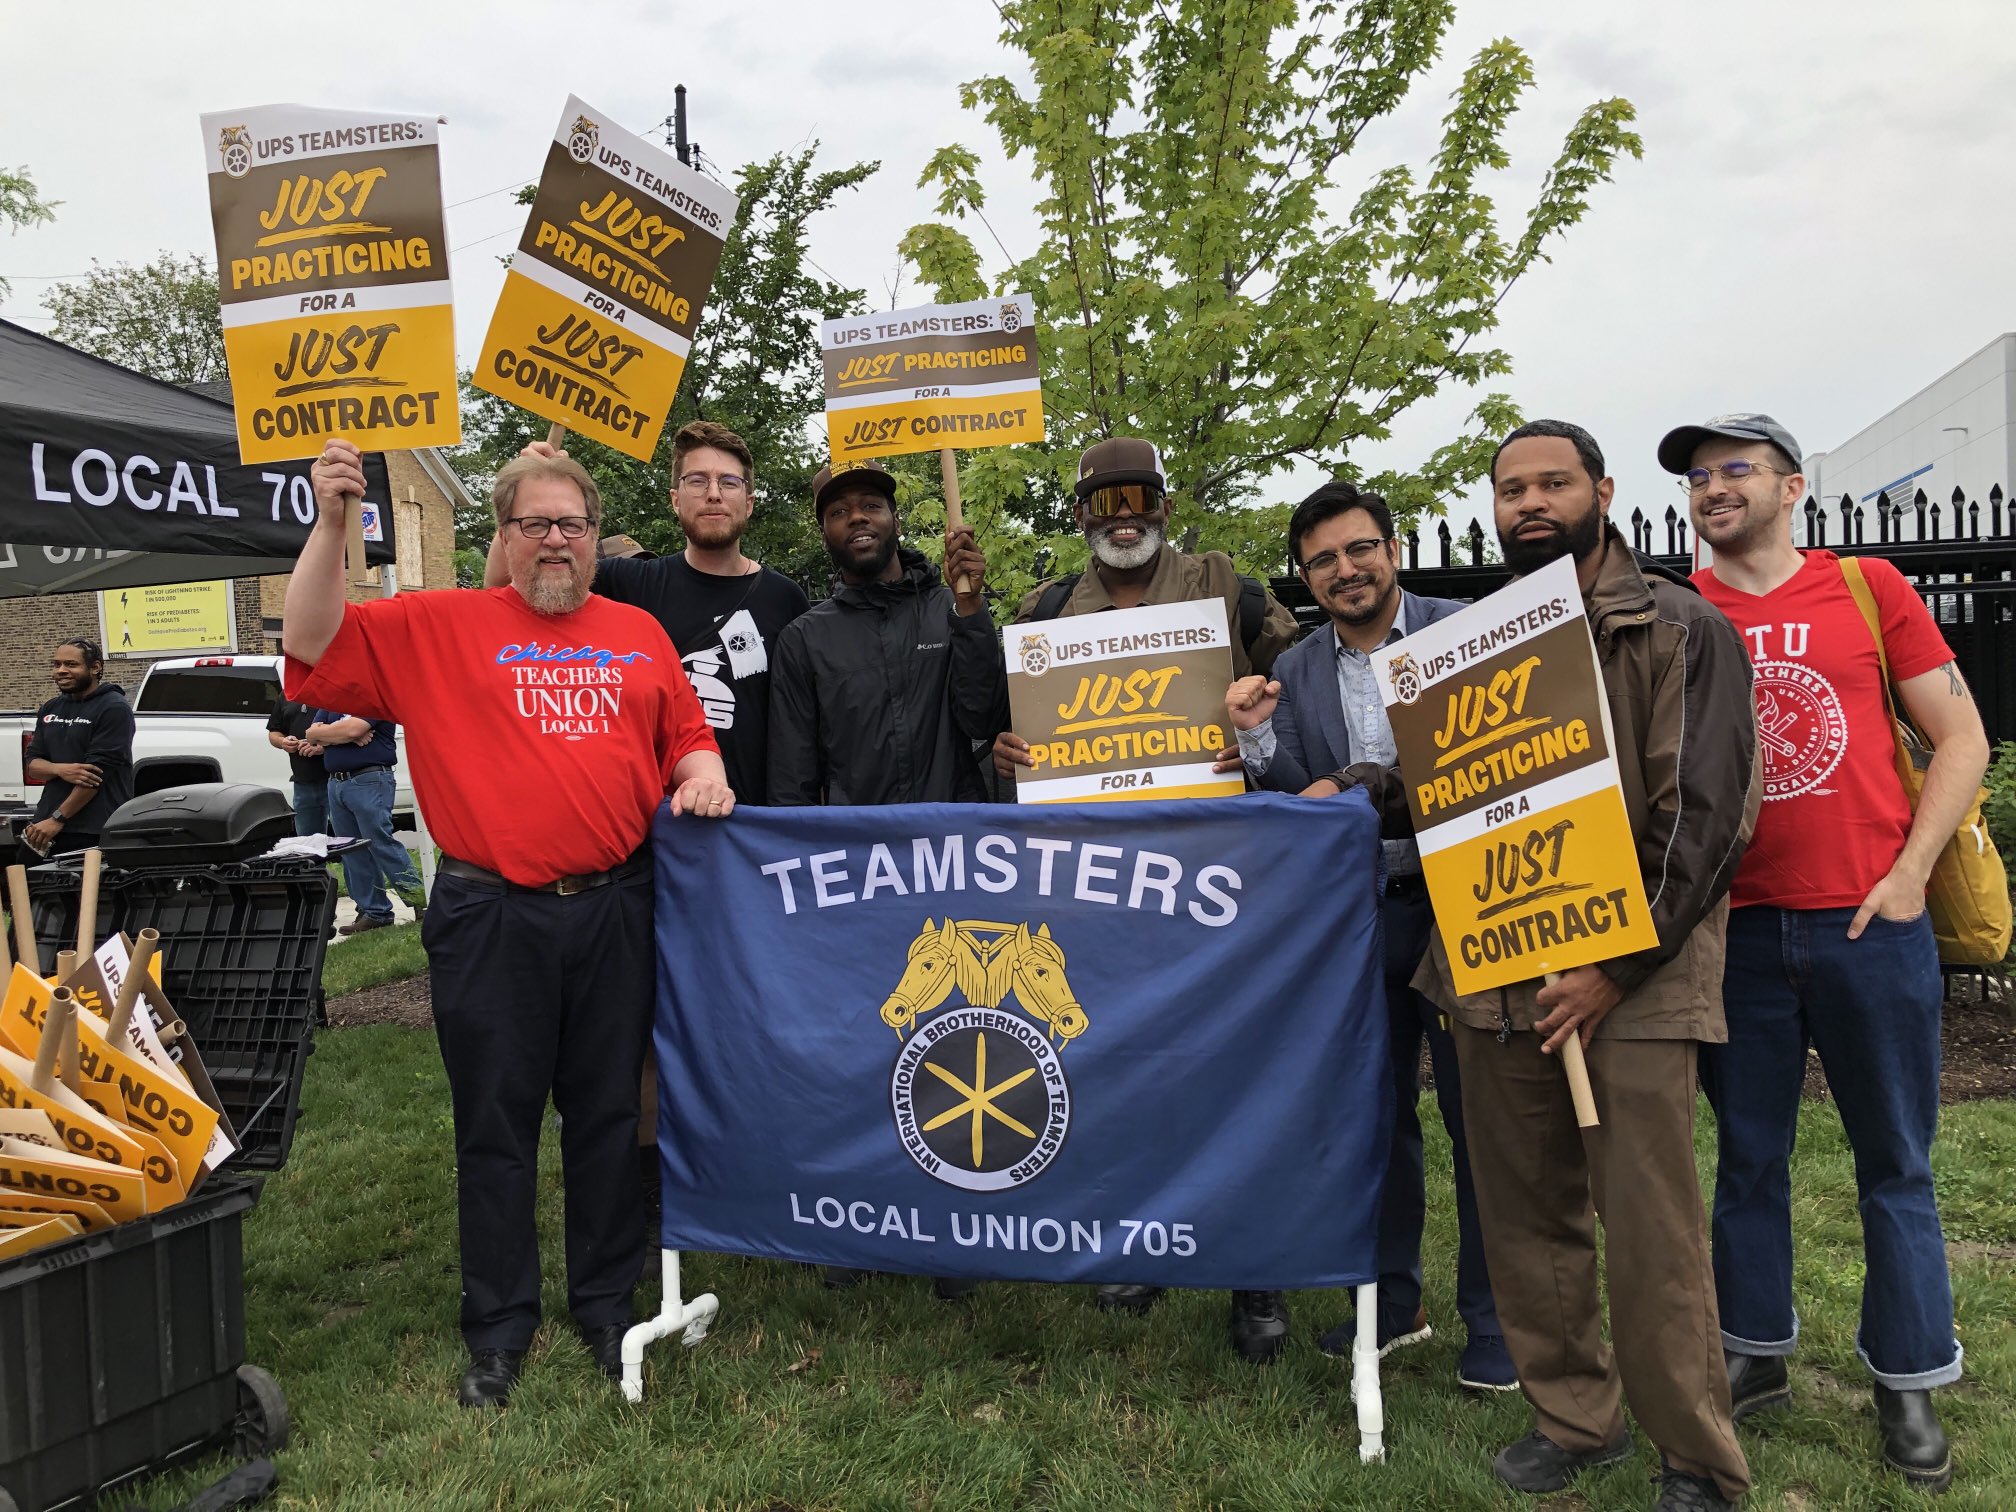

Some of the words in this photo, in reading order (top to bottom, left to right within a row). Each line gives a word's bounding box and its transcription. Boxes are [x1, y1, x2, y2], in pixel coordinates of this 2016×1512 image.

[257, 135, 294, 159] UPS
[298, 121, 424, 154] TEAMSTERS:
[260, 167, 387, 230] JUST
[598, 145, 632, 177] UPS
[634, 165, 723, 231] TEAMSTERS:
[579, 190, 686, 258] JUST
[231, 237, 432, 290] PRACTICING
[535, 222, 690, 325] PRACTICING
[300, 295, 337, 313] FOR
[340, 293, 356, 310] A
[584, 291, 613, 317] FOR
[612, 306, 626, 323] A
[274, 322, 401, 381] JUST
[537, 313, 643, 376] JUST
[833, 328, 872, 345] UPS
[876, 314, 994, 340] TEAMSTERS:
[837, 351, 901, 380] JUST
[904, 345, 1027, 372] PRACTICING
[252, 392, 440, 441] CONTRACT
[493, 348, 651, 439] CONTRACT
[914, 387, 942, 399] FOR
[942, 387, 951, 397] A
[844, 416, 907, 445] JUST
[911, 408, 1027, 436] CONTRACT
[31, 442, 239, 518] LOCAL
[261, 472, 315, 525] 70
[496, 641, 652, 667] Chicago
[1056, 642, 1093, 661] UPS
[1097, 627, 1216, 655] TEAMSTERS:
[1423, 652, 1455, 681] UPS
[1458, 597, 1570, 664] TEAMSTERS:
[1745, 623, 1811, 661] TU
[512, 667, 623, 686] TEACHERS
[1058, 666, 1182, 719] JUST
[1779, 688, 1812, 712] UNITE
[514, 688, 622, 717] UNION
[1434, 655, 1542, 749] JUST
[1754, 668, 1822, 693] ACHERS
[1821, 696, 1841, 751] UNION
[540, 720, 598, 734] LOCAL
[602, 720, 610, 733] 1
[1030, 724, 1225, 771] PRACTICING
[1791, 727, 1818, 766] DEFEND
[1101, 773, 1136, 790] FOR
[1141, 772, 1154, 785] A
[1417, 719, 1590, 816] PRACTICING
[1766, 775, 1811, 793] OCAL
[1812, 765, 1823, 775] 1
[1486, 799, 1515, 827] FOR
[1518, 796, 1531, 816] A
[760, 834, 1243, 928] TEAMSTERS
[1472, 819, 1575, 903] JUST
[1460, 889, 1630, 969] CONTRACT
[923, 1012, 1050, 1059] BROTHERHOOD
[1043, 1060, 1062, 1086] OF
[896, 1043, 941, 1174] INTERNATIONAL
[1009, 1089, 1066, 1183] TEAMSTERS
[789, 1192, 936, 1243] LOCAL
[950, 1212, 1101, 1254] UNION
[1118, 1220, 1198, 1257] 705
